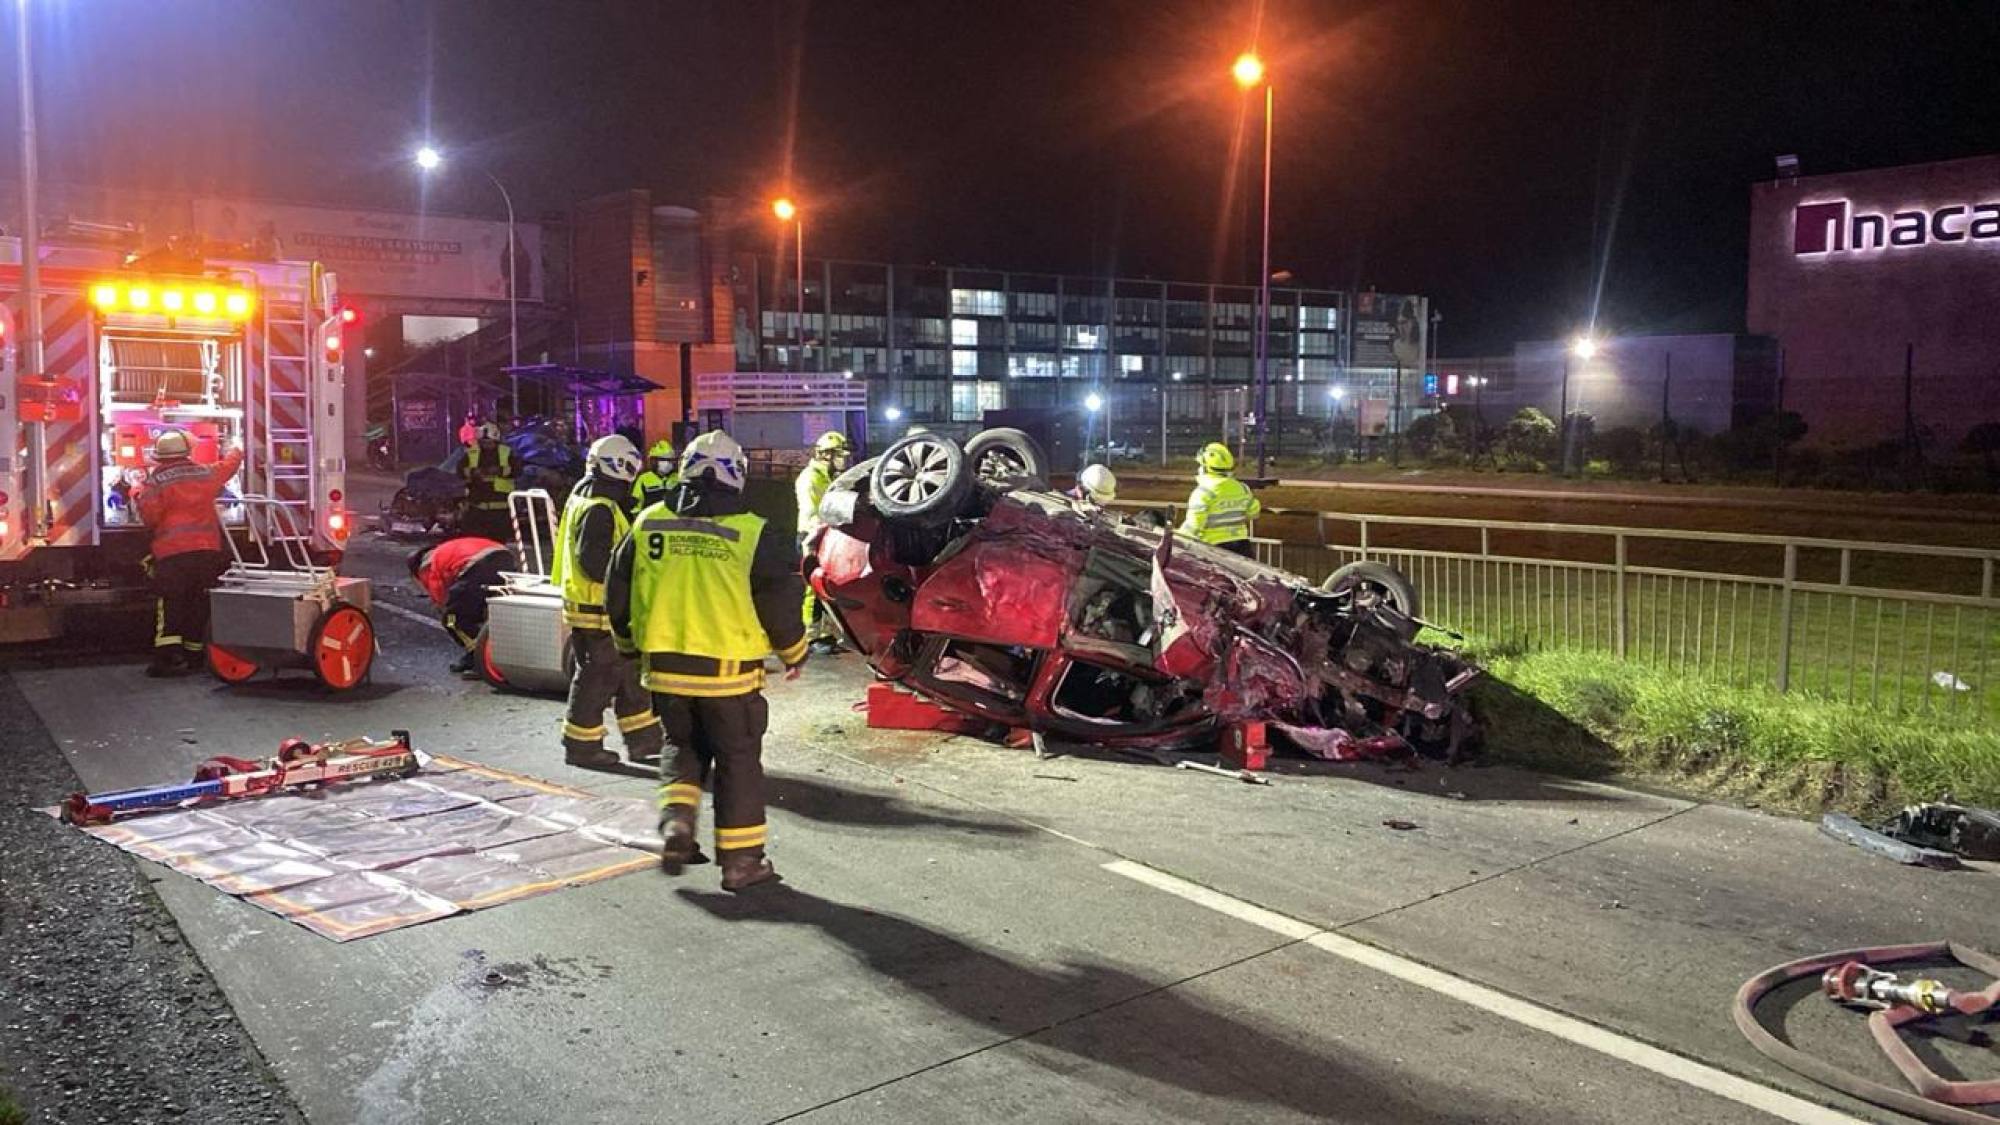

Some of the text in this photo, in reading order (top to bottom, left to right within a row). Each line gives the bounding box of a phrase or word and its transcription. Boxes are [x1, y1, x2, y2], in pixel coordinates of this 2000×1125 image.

[648, 533, 664, 560] 9
[669, 535, 721, 548] BOMBEROS
[339, 760, 379, 772] RESCUE
